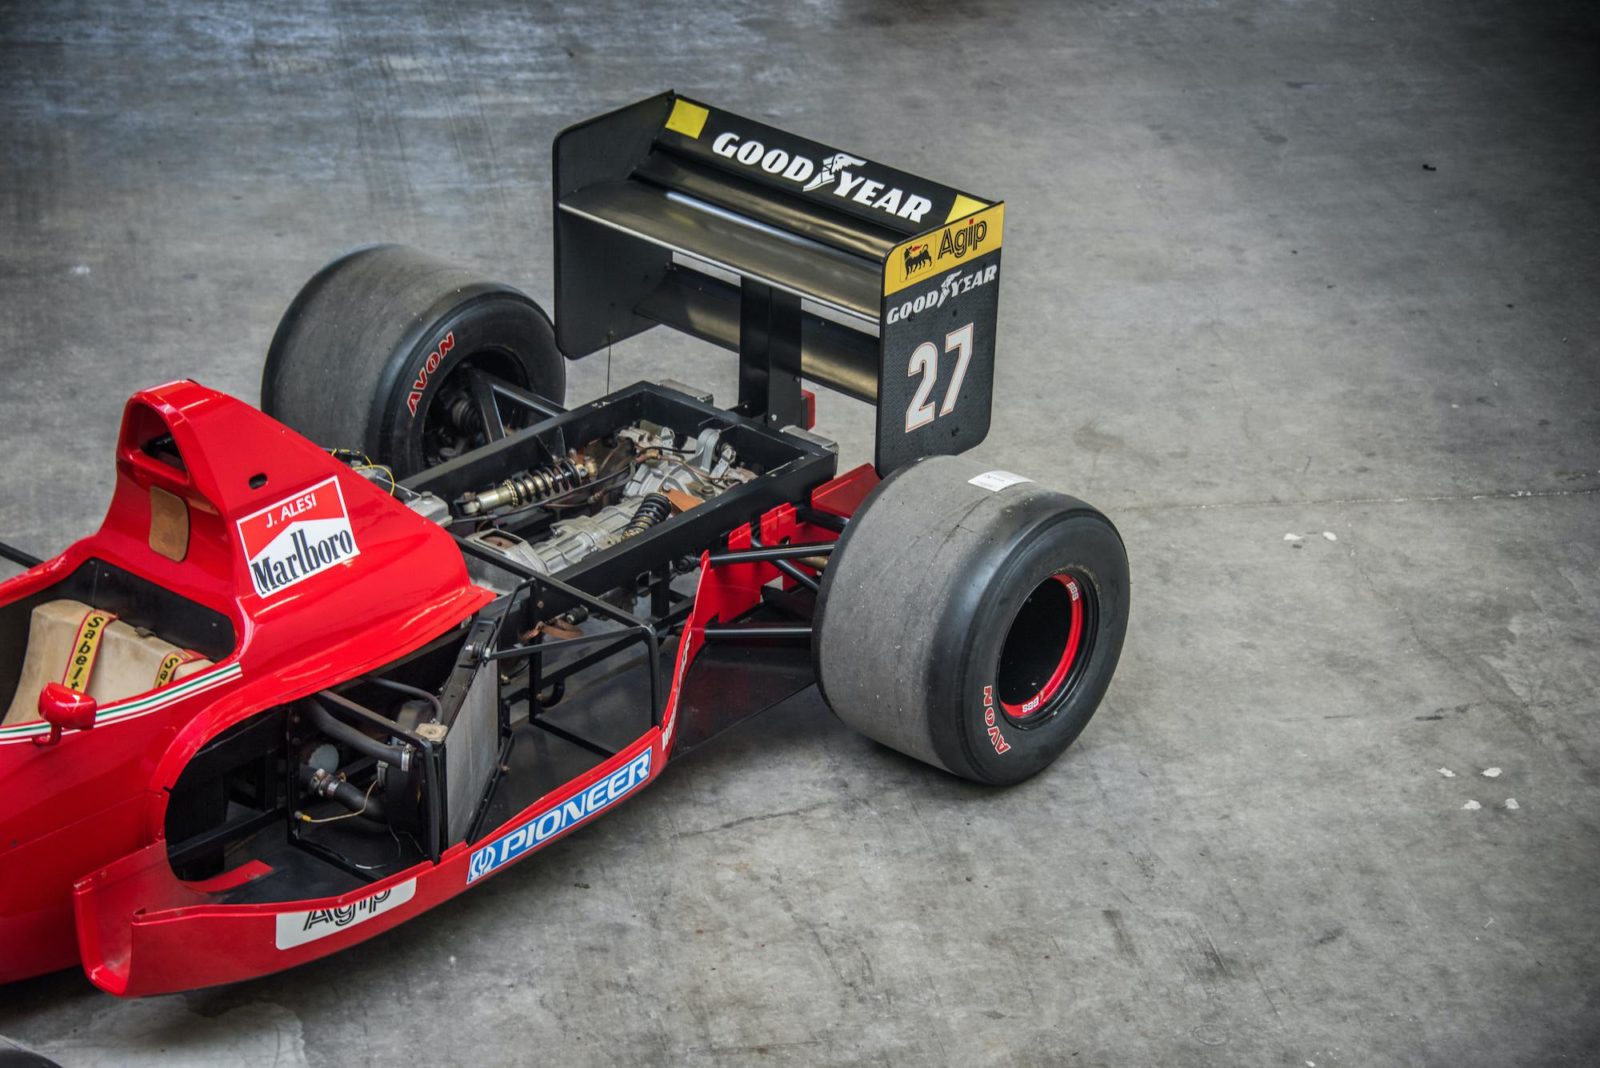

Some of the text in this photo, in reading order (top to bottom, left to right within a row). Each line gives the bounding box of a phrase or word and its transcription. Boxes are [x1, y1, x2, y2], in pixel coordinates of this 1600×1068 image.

[712, 132, 932, 223] GOODYEAR
[937, 218, 988, 260] Agip
[886, 264, 998, 325] GOODYEAR
[407, 330, 455, 418] AVON
[905, 322, 974, 433] 27
[265, 492, 317, 529] J. ALESI
[250, 528, 353, 595] Marlboro
[983, 685, 1011, 755] AVON
[500, 753, 650, 862] PIONEER
